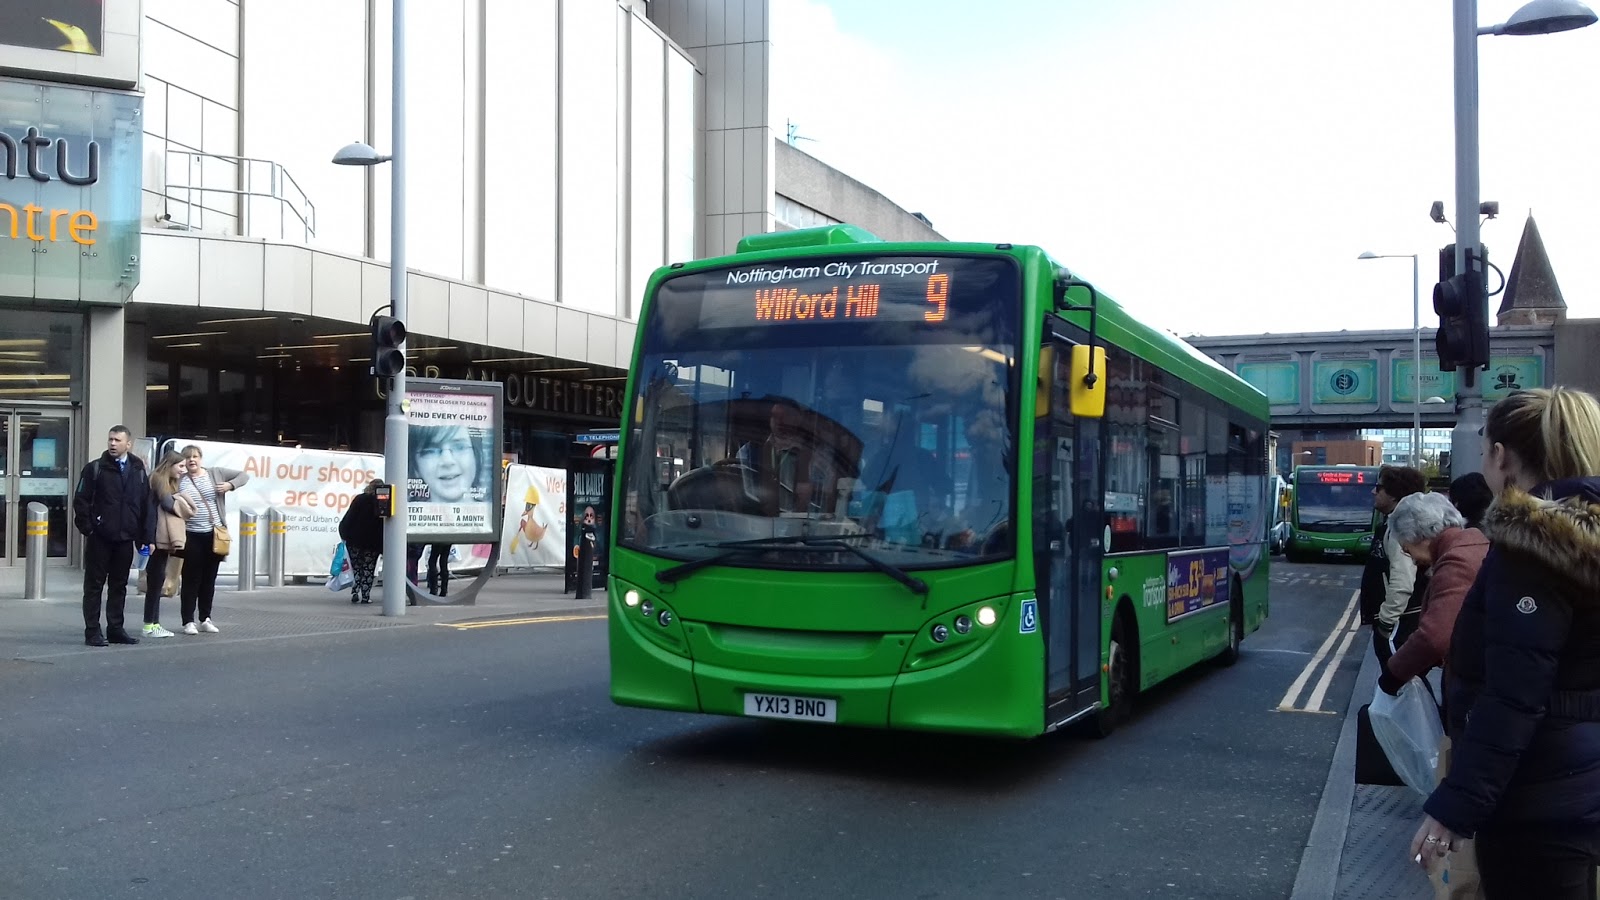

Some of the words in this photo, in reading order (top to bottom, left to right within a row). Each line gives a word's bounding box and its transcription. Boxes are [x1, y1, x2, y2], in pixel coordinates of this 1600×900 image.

[726, 266, 820, 285] Nottingham
[823, 262, 857, 278] City
[861, 260, 939, 277] Transport
[755, 286, 838, 320] Wilford
[845, 285, 879, 317] Hill
[924, 273, 949, 322] 9
[460, 413, 488, 421] CHILD?
[243, 456, 271, 478] All
[276, 463, 313, 480] our
[317, 461, 376, 488] shops
[1357, 472, 1363, 482] 5
[284, 489, 318, 507] are
[409, 488, 430, 498] child
[754, 696, 790, 714] YX13
[794, 699, 826, 717] BNO
